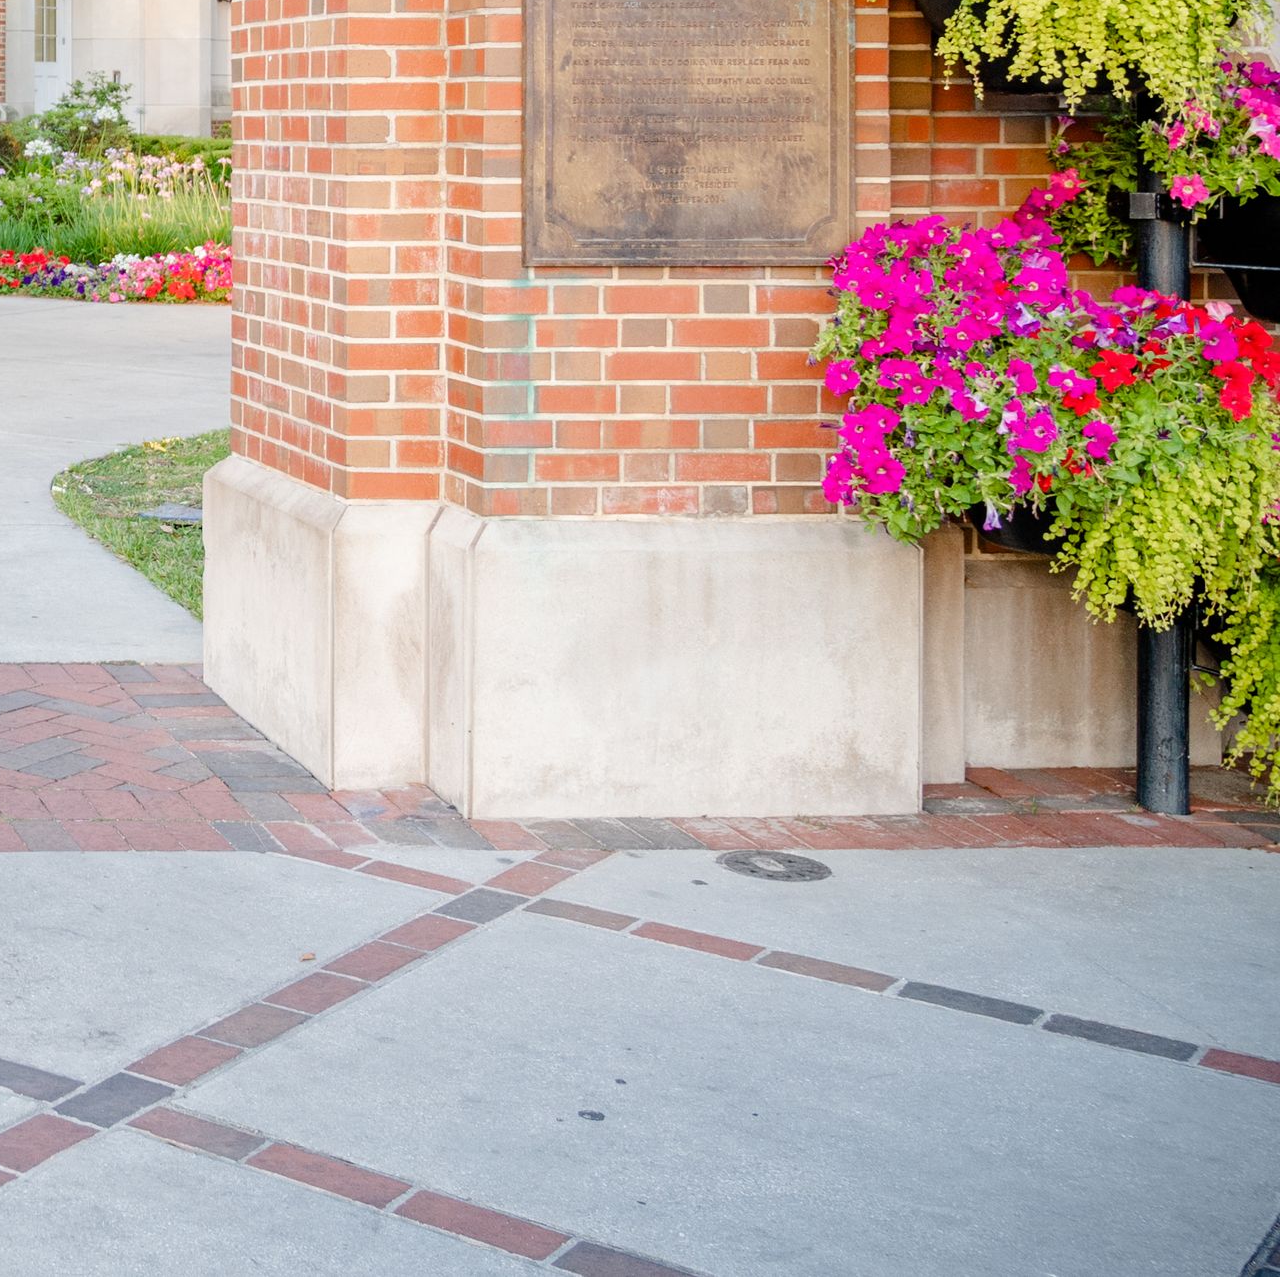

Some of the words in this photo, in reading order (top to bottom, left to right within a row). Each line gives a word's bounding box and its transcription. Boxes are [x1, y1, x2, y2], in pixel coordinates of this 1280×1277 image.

[710, 58, 724, 66] WE
[727, 58, 765, 66] REPLACE
[768, 58, 789, 66] FEAR
[792, 58, 810, 66] AND
